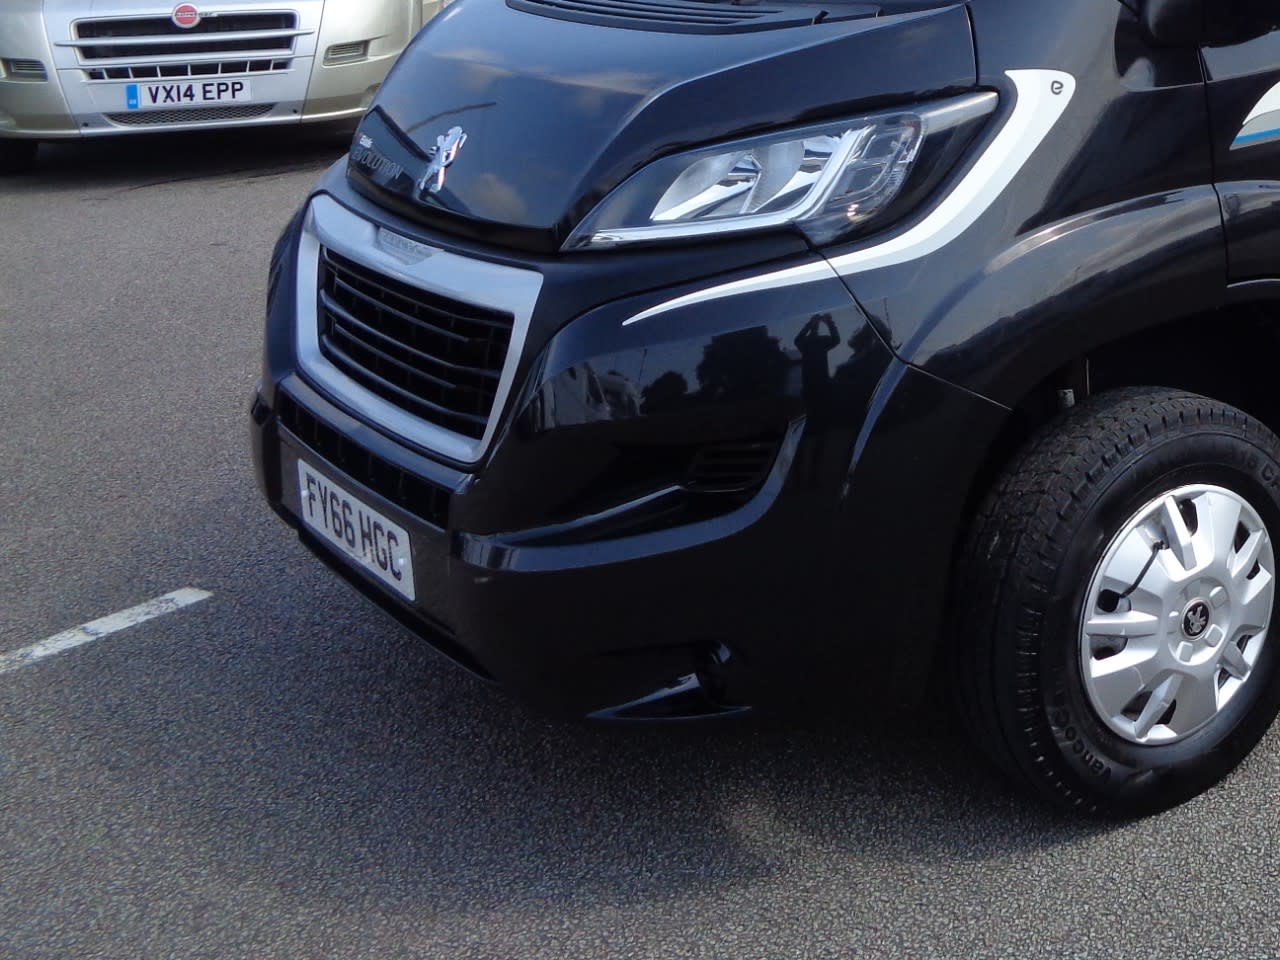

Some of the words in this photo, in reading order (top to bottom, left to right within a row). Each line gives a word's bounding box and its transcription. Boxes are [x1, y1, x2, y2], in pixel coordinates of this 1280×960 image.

[147, 83, 195, 104] VX14
[201, 81, 244, 101] EPP
[305, 472, 356, 550] FY66
[358, 510, 403, 582] HGC
